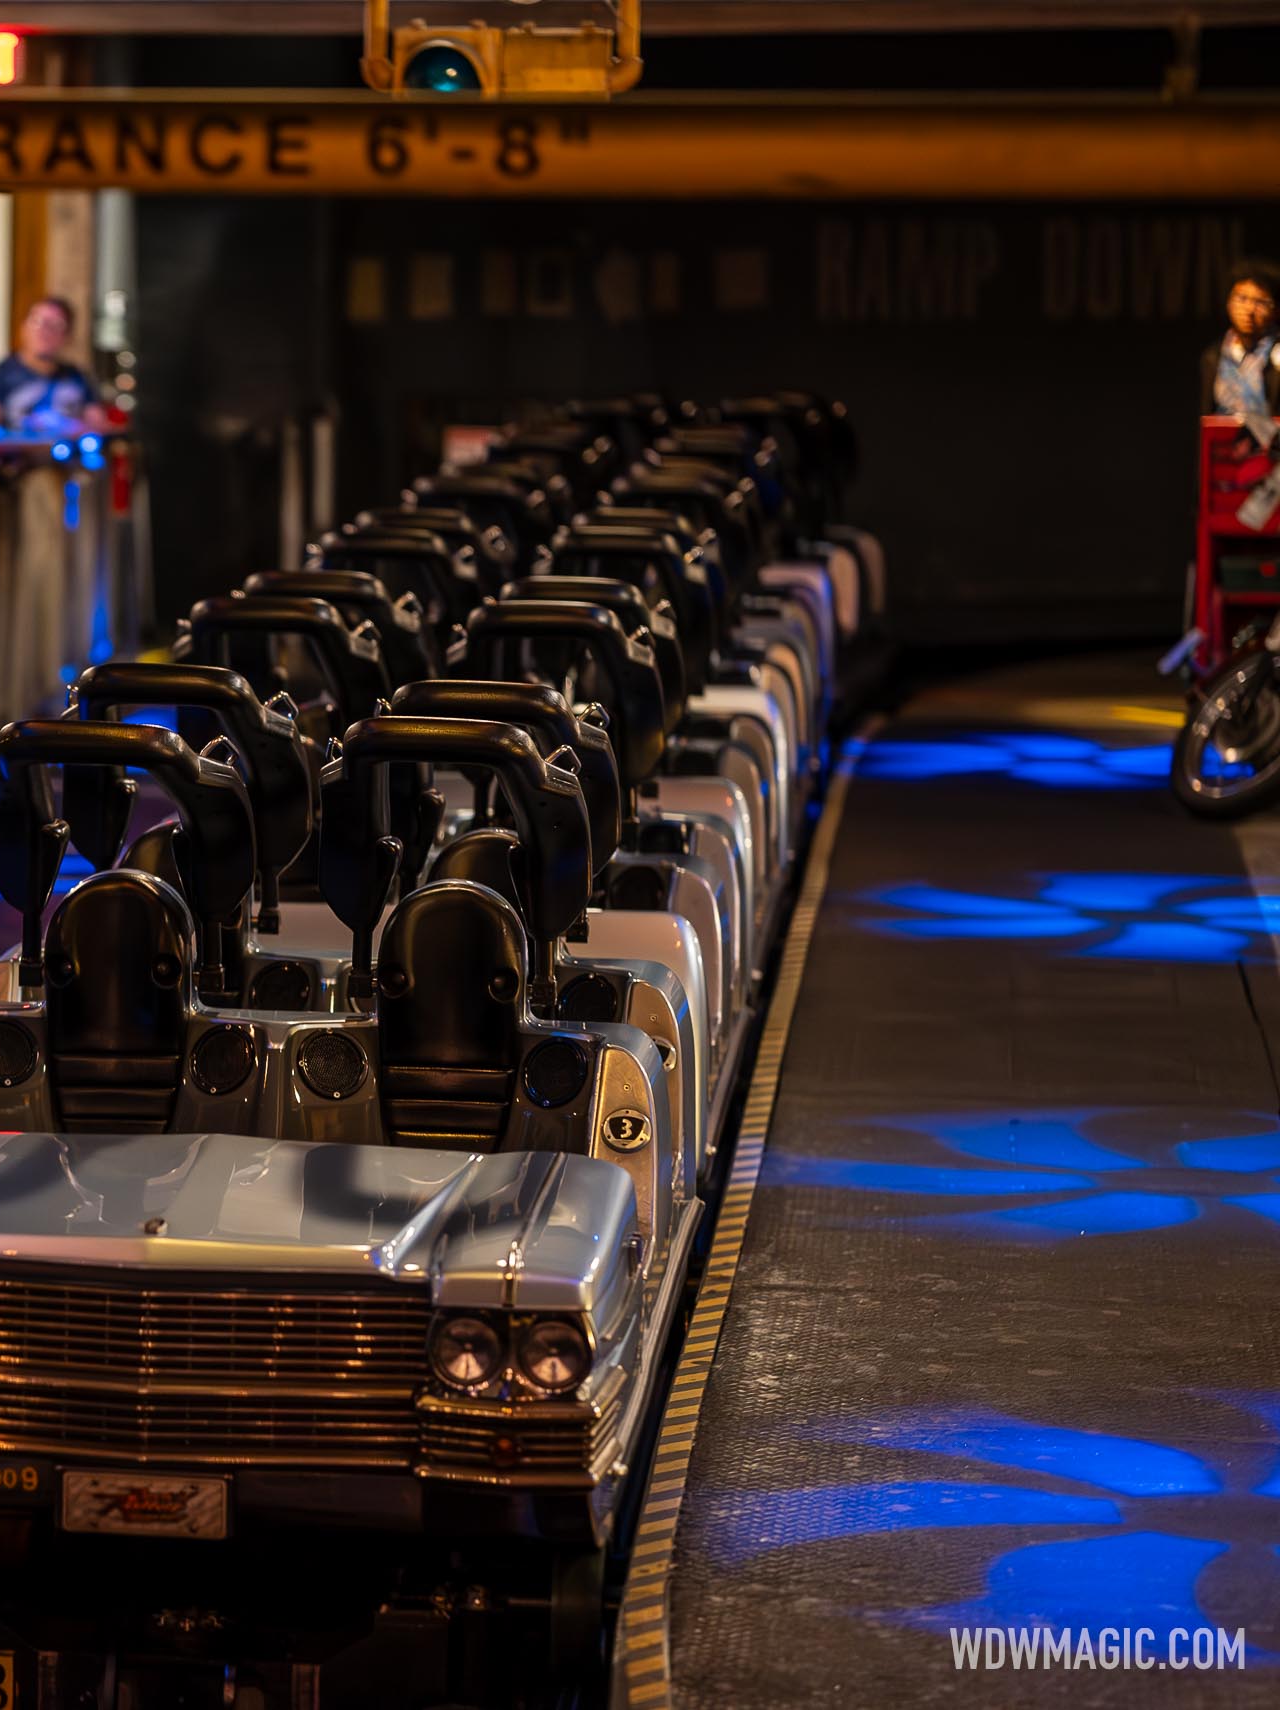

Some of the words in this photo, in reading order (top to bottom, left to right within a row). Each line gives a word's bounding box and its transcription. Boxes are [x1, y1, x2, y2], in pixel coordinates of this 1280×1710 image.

[366, 112, 589, 178] 6'-8"
[812, 217, 1002, 319] RAMP
[1042, 217, 1246, 319] DOWN
[620, 1119, 633, 1139] 3
